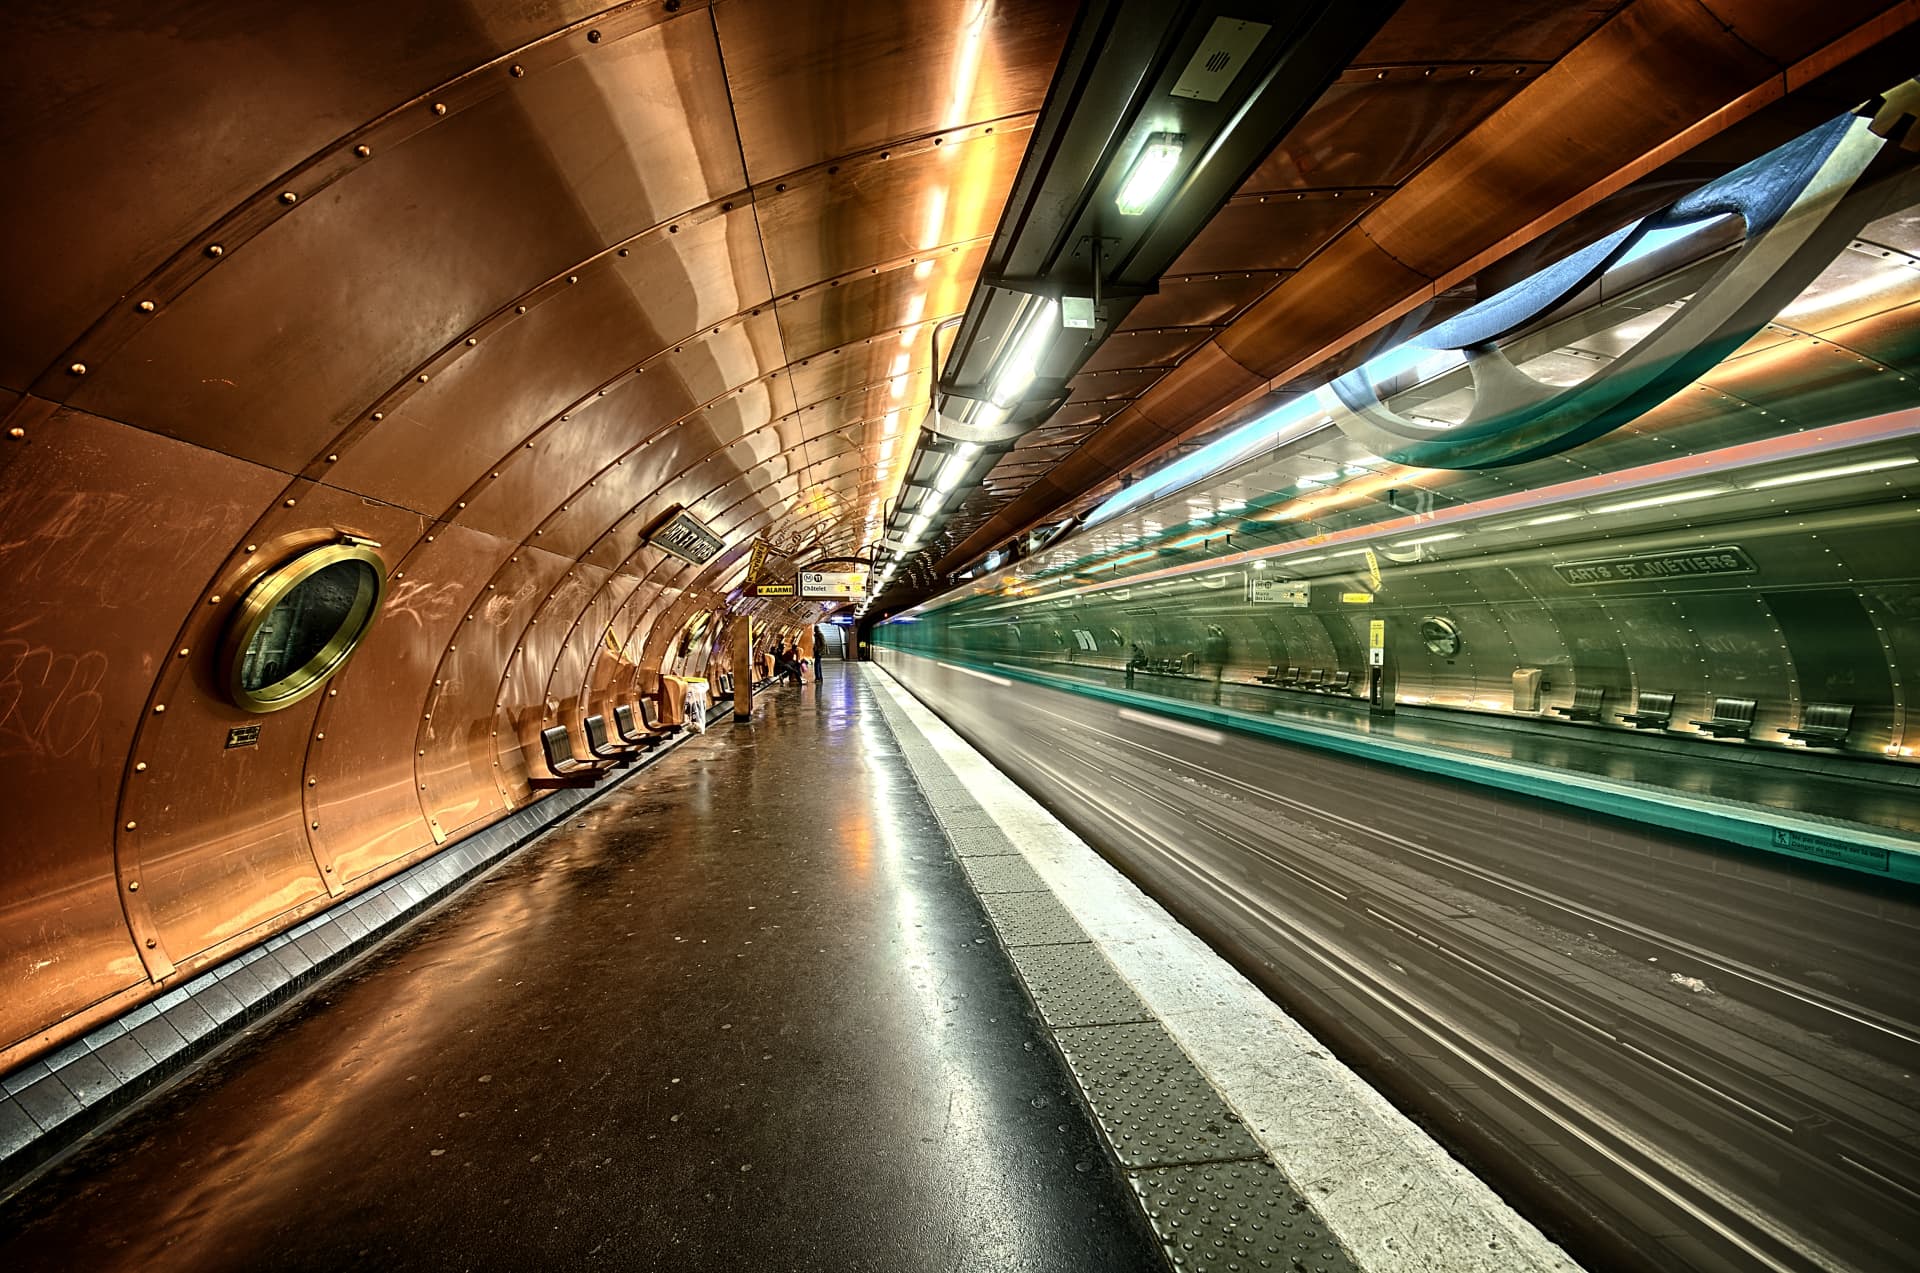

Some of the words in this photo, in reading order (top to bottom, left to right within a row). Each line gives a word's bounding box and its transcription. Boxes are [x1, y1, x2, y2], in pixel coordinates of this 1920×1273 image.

[662, 522, 690, 544] ARTS
[679, 532, 698, 549] ET
[1568, 566, 1612, 581] ARTS
[1615, 563, 1639, 576] ET
